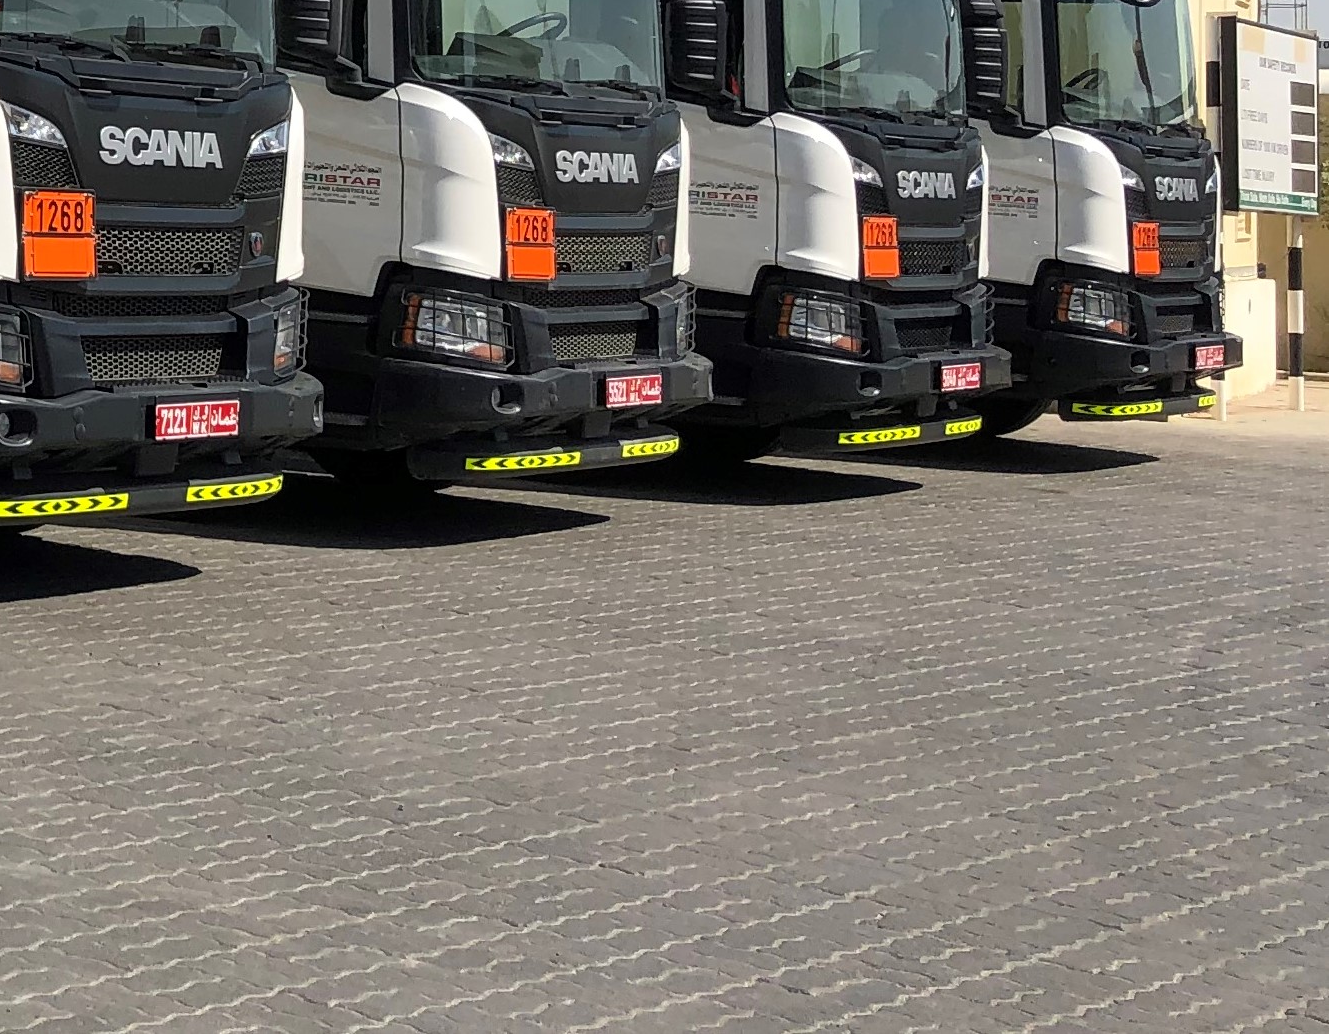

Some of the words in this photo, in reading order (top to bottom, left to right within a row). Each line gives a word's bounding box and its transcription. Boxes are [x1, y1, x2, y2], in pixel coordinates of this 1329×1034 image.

[99, 125, 223, 169] SCANIA
[304, 173, 381, 186] RISTAR
[555, 150, 639, 184] SCANIA
[689, 190, 758, 201] RISTAR
[896, 170, 956, 199] SCANIA
[1155, 176, 1199, 201] SCANIA
[991, 194, 1038, 203] STAR
[36, 198, 84, 232] 1268
[516, 215, 548, 242] 1268
[161, 407, 187, 434] 7121
